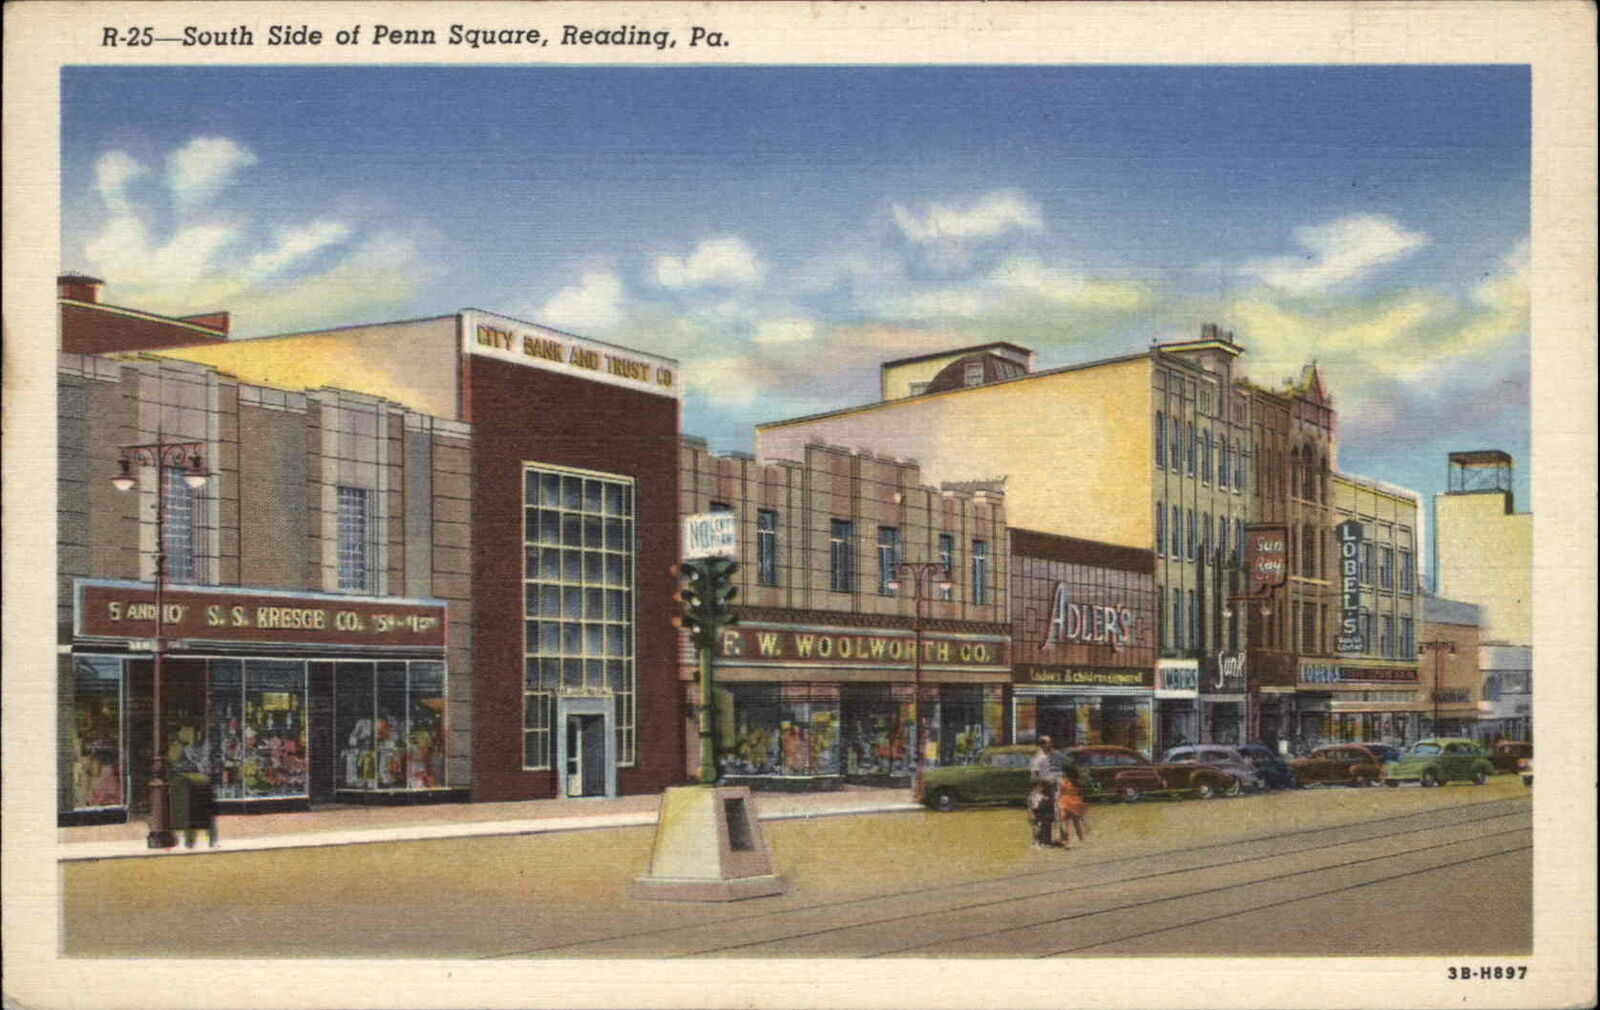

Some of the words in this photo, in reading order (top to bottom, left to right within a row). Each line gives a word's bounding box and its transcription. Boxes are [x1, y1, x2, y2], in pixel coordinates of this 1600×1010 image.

[476, 325, 513, 350] CITY
[523, 334, 564, 363] BANK
[569, 344, 600, 371] AND
[604, 353, 651, 382] TRUST
[656, 365, 673, 387] CO
[127, 602, 158, 621] AND
[207, 605, 226, 626] S.
[231, 605, 249, 626] S.
[256, 606, 327, 630] KRESGE
[335, 612, 365, 632] CO.
[722, 630, 741, 656] F.
[757, 631, 783, 657] W.
[795, 633, 949, 662] WOOLWORTH
[959, 643, 992, 663] CO.
